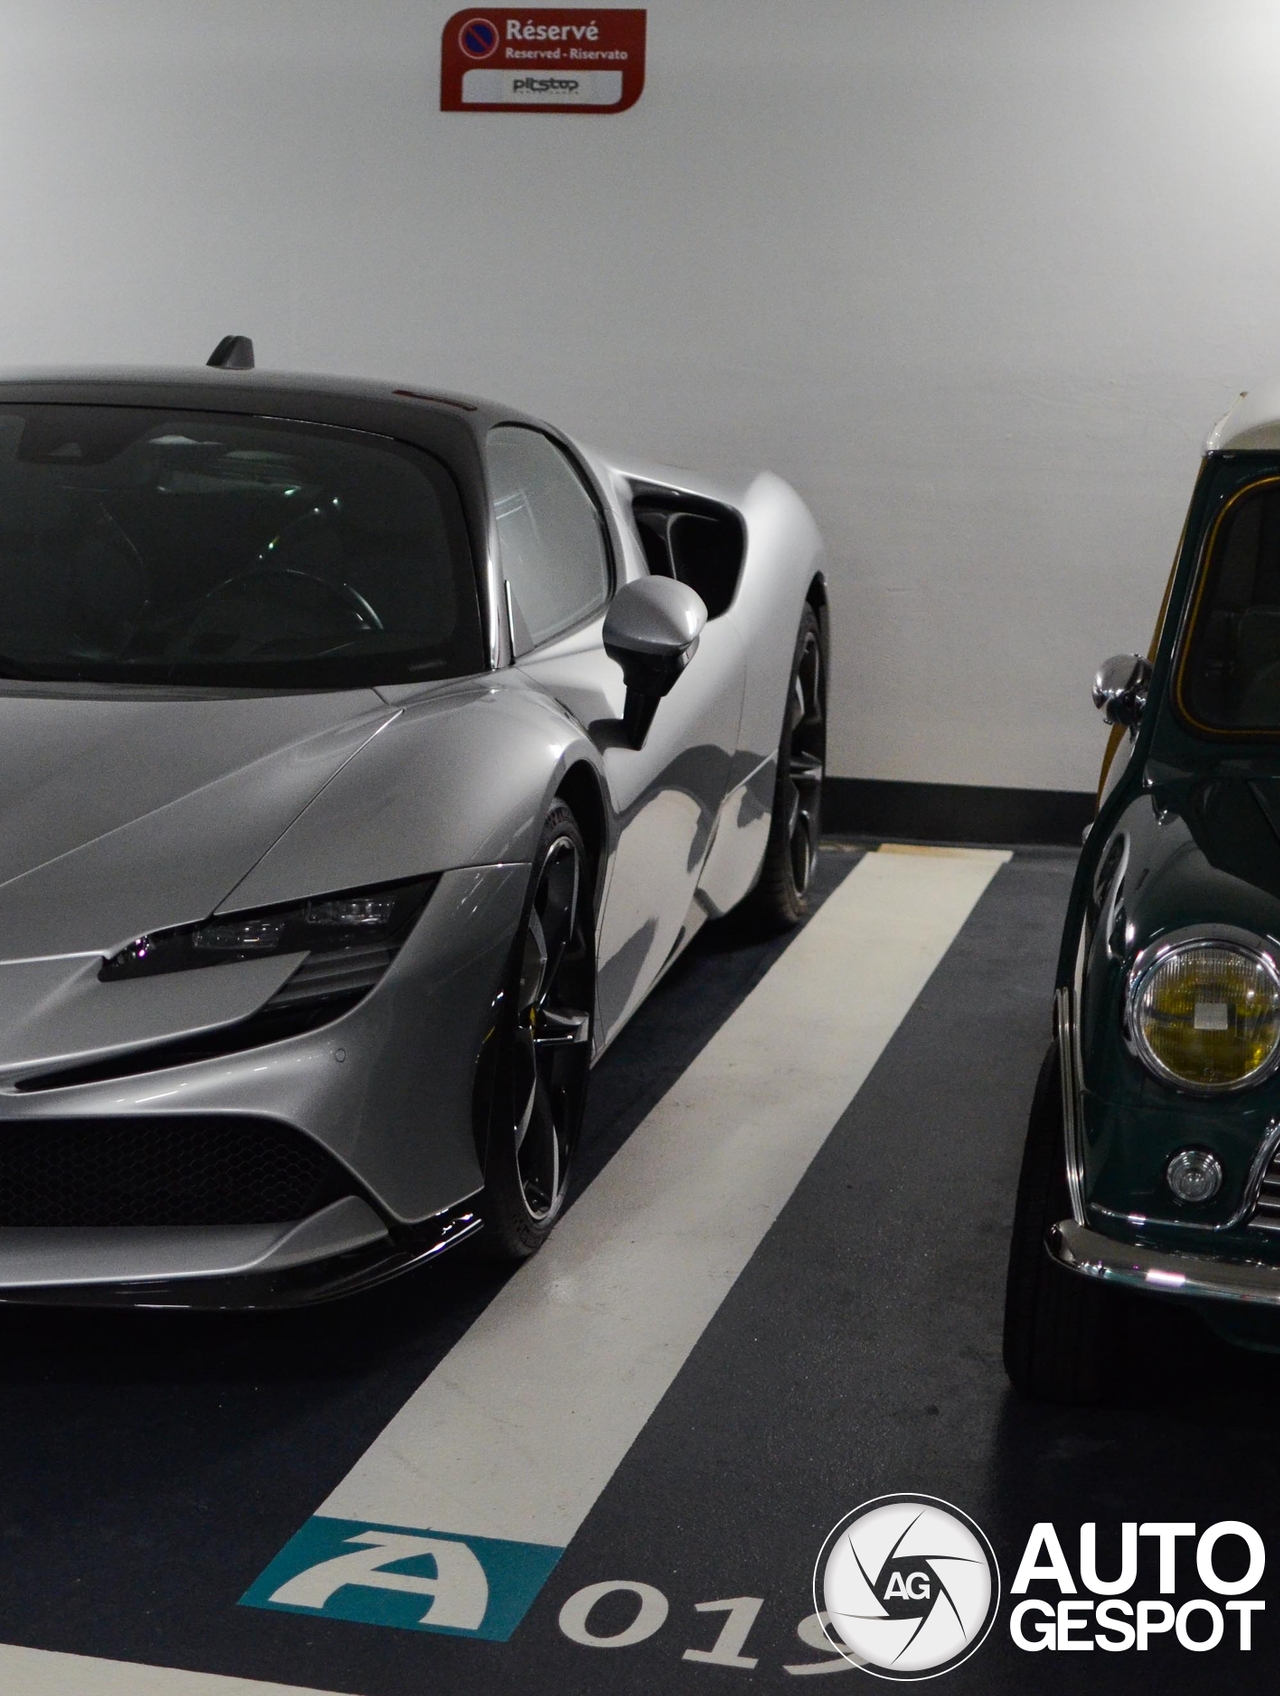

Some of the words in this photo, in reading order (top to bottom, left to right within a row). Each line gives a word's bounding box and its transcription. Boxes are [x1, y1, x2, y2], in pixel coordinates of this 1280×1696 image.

[506, 19, 599, 40] Réservé
[505, 47, 561, 59] Reserved
[570, 48, 628, 60] Riservato
[268, 1530, 489, 1630] A
